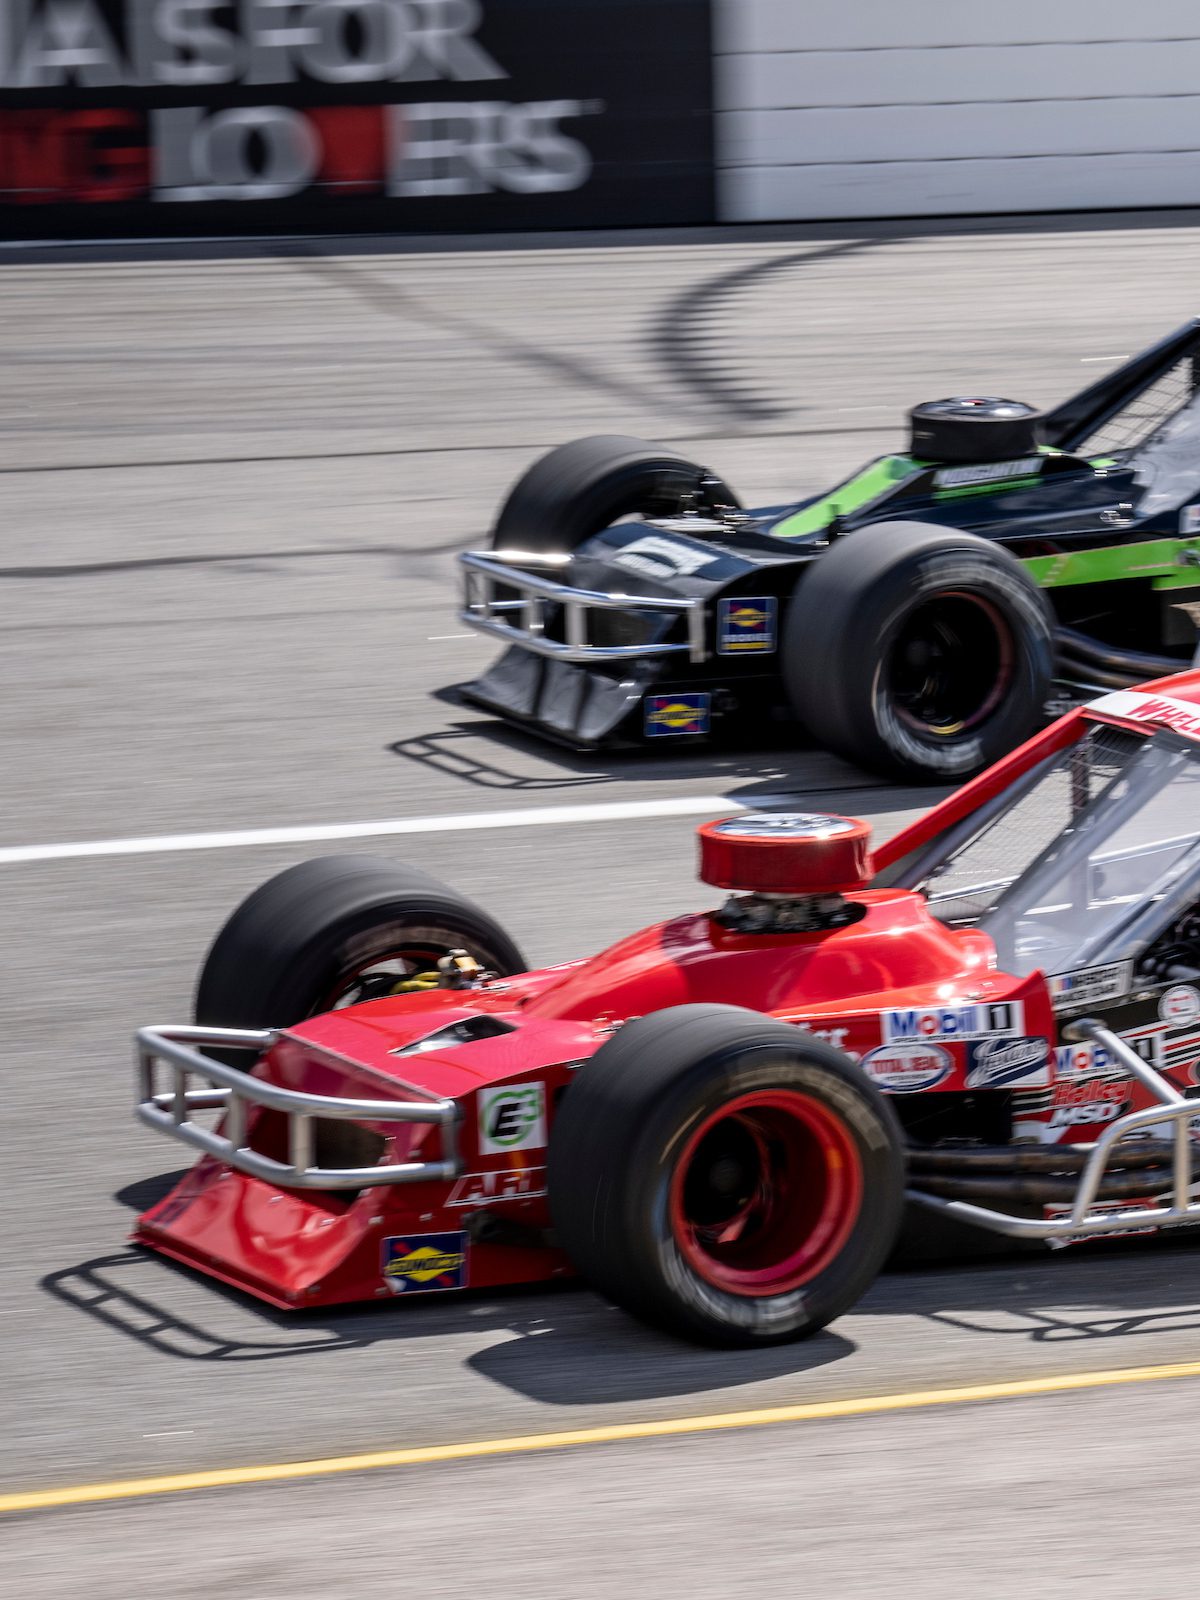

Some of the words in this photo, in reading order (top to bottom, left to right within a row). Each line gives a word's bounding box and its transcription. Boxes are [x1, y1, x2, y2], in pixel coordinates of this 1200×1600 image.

[890, 1005, 977, 1036] Mobil
[1056, 1045, 1118, 1072] Mob
[1050, 1101, 1124, 1128] MSD
